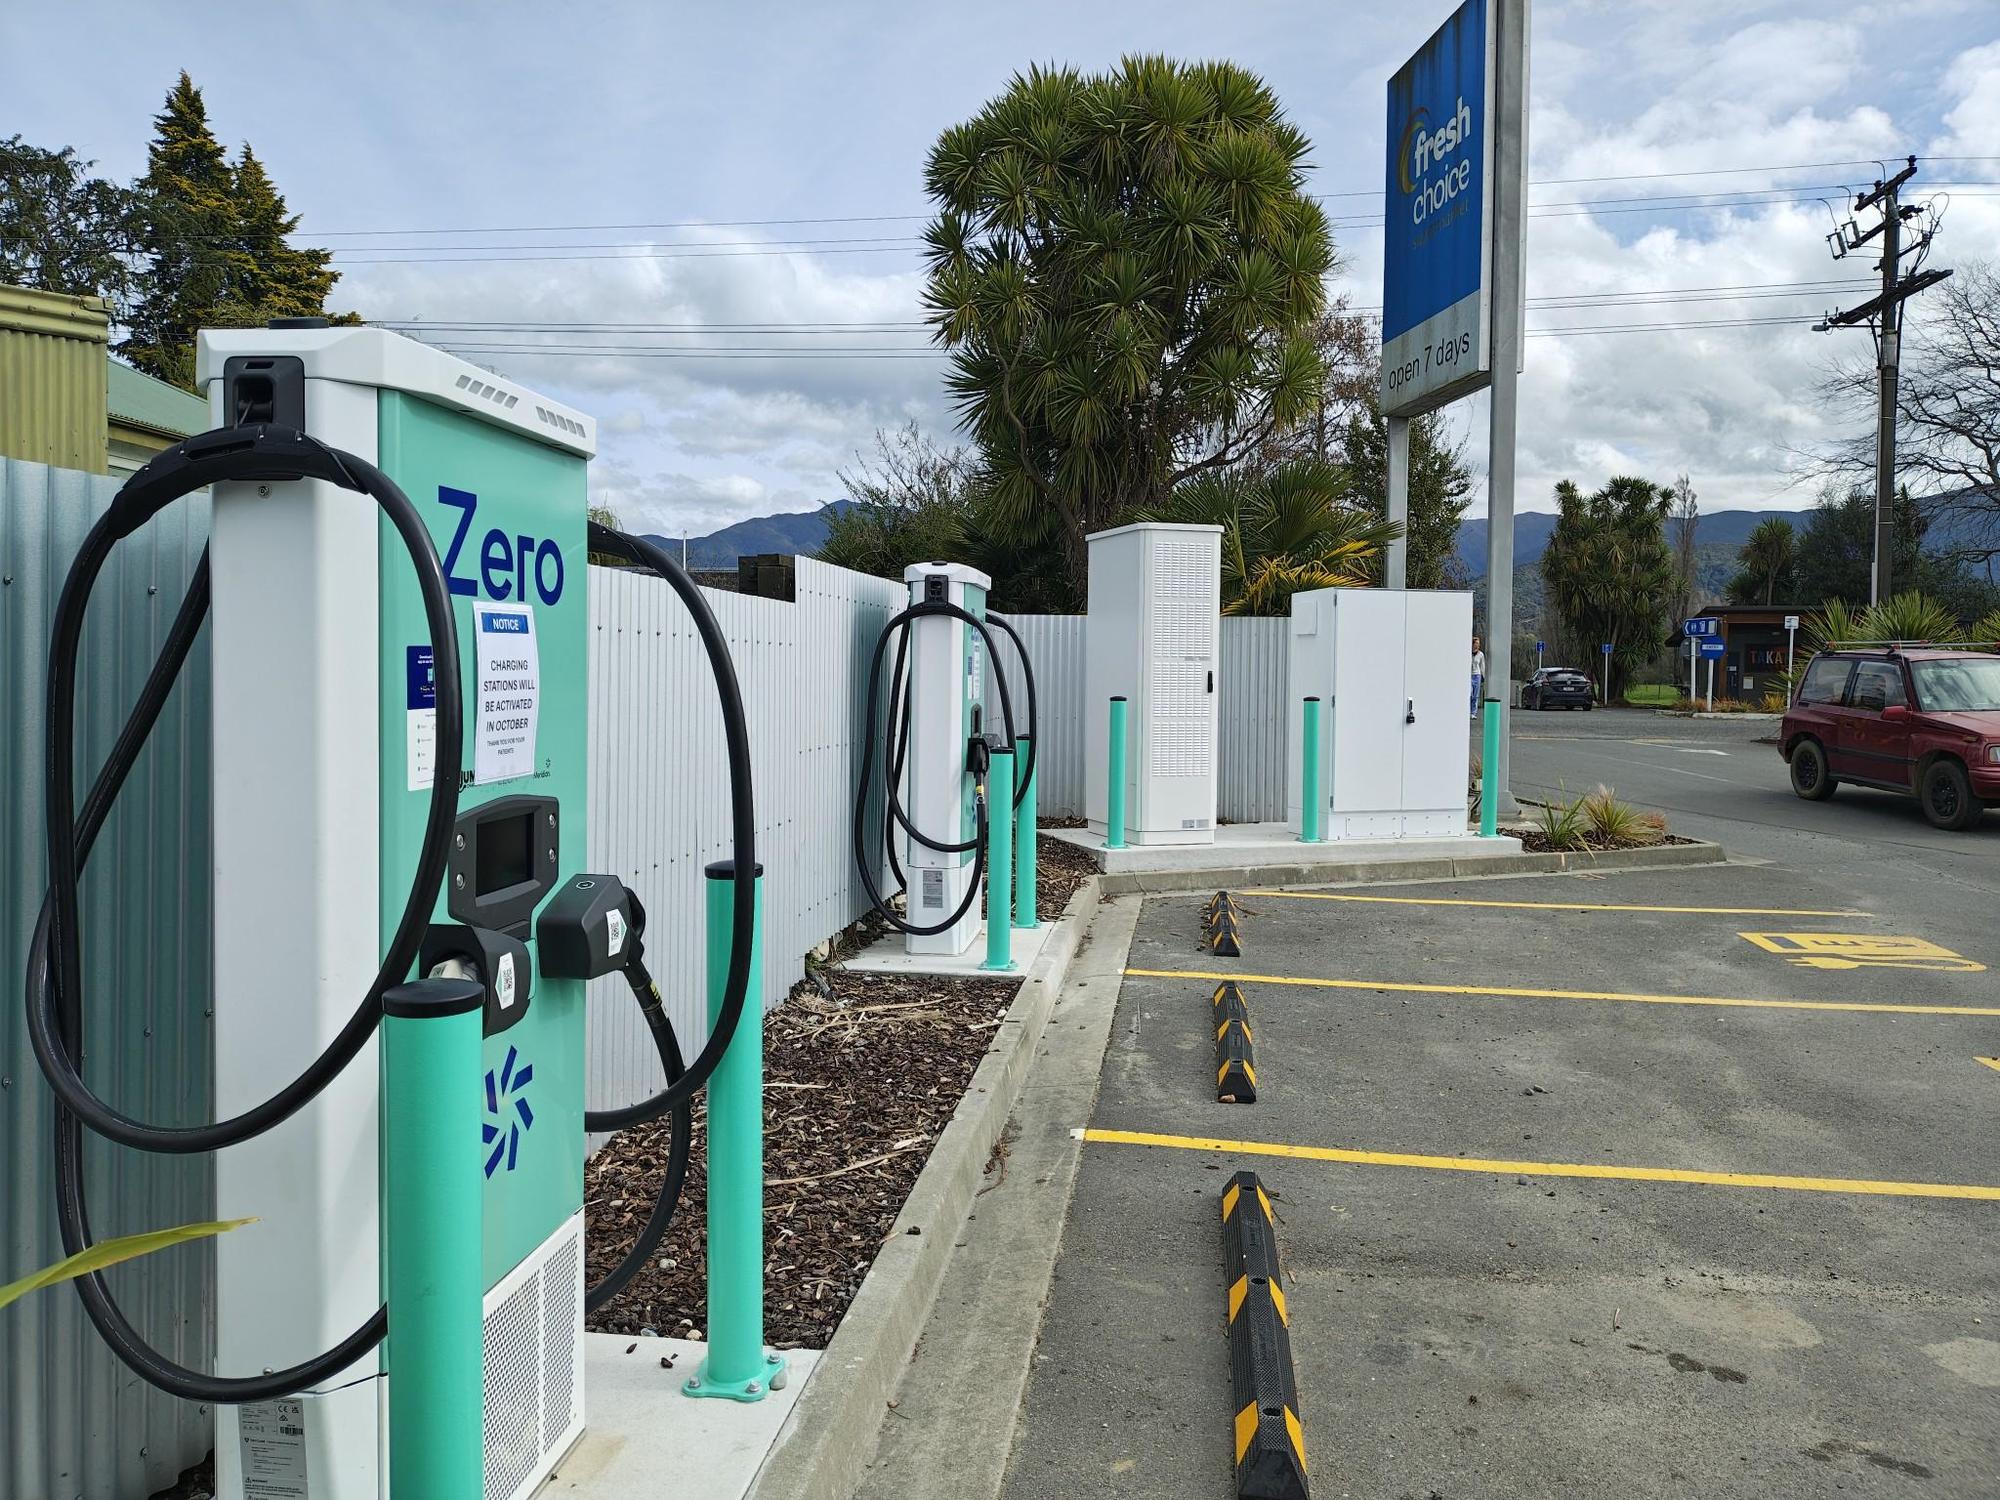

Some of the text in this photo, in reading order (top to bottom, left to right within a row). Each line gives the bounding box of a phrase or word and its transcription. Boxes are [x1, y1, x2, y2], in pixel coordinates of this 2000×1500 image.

[1415, 96, 1470, 178] fresh
[1413, 159, 1469, 224] choice
[1389, 332, 1469, 392] open 7 days
[438, 485, 564, 606] Zero
[492, 618, 519, 630] NOTICE
[491, 660, 528, 671] CHARGING
[484, 680, 535, 691] STATIONS WILL
[485, 699, 532, 712] BE ACTIVATED
[487, 718, 528, 731] IN OCTOBER
